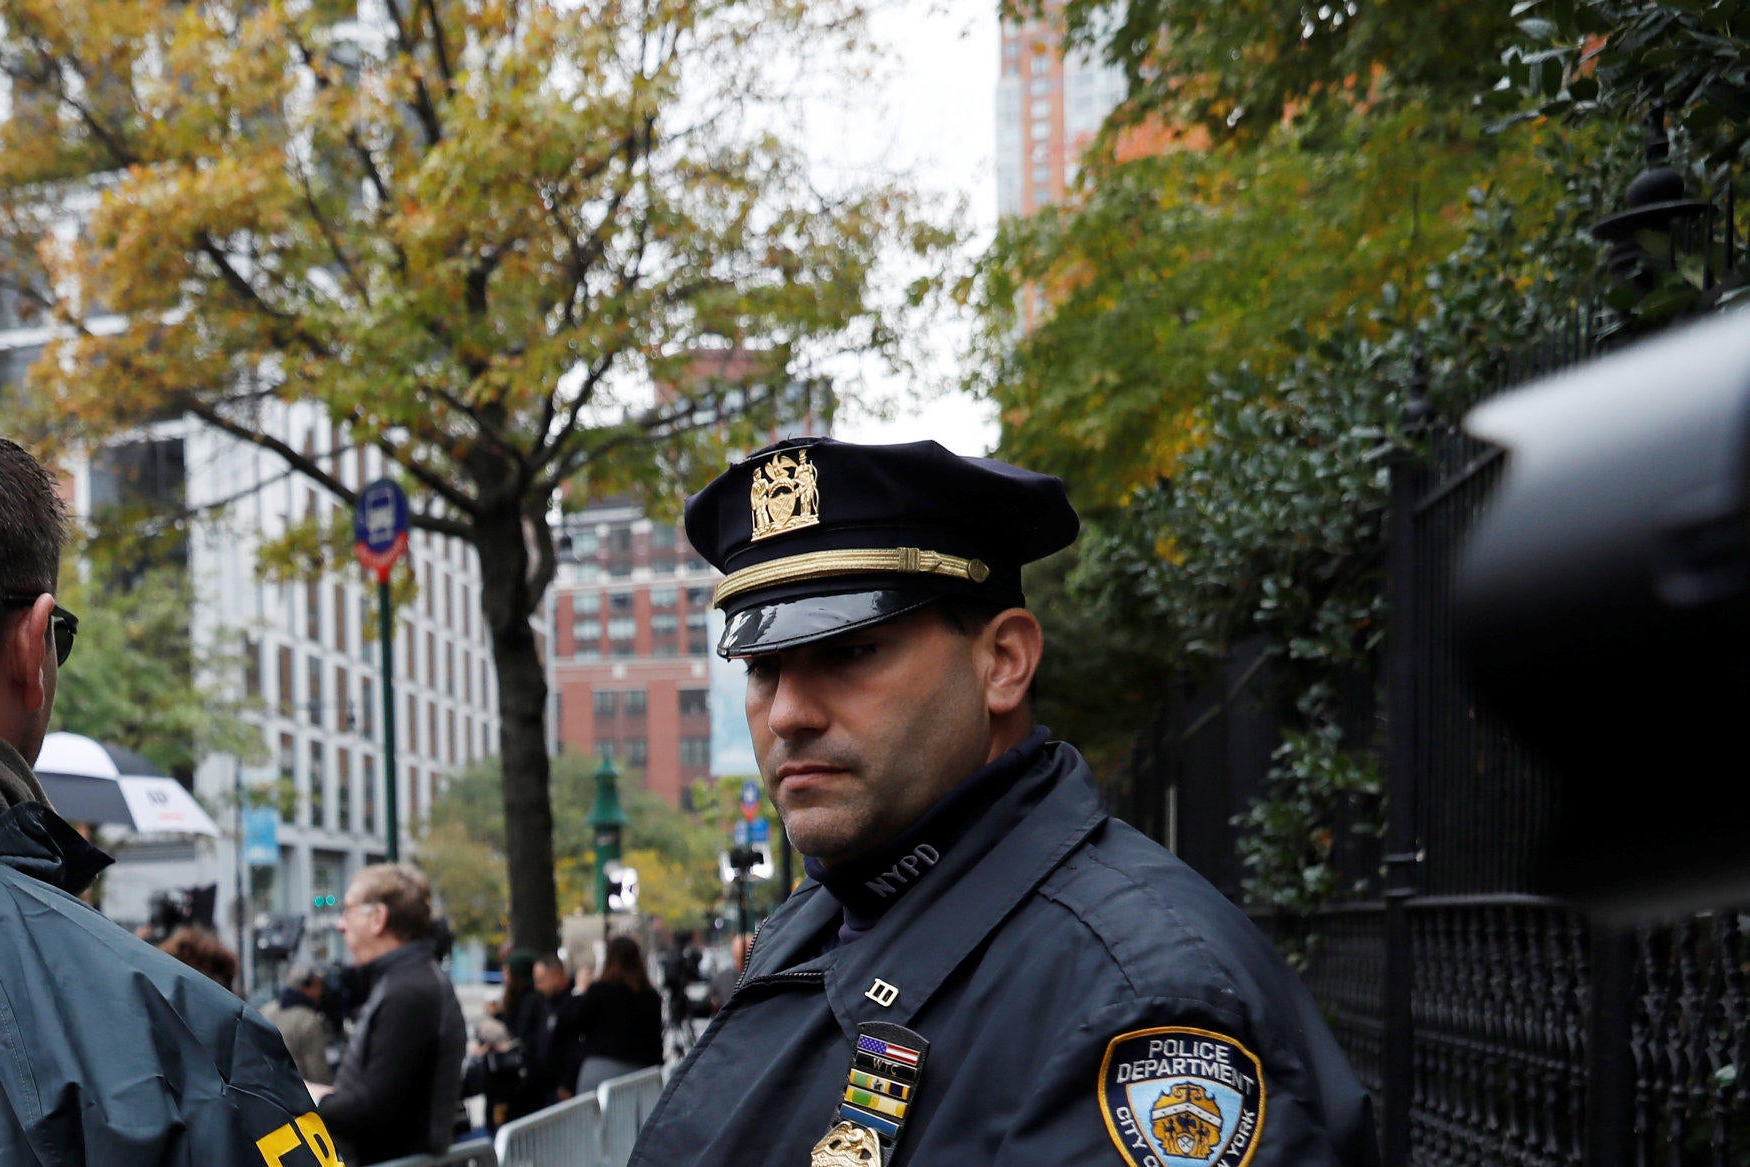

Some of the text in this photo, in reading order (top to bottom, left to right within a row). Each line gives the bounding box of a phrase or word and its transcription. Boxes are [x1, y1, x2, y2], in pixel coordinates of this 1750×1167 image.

[864, 843, 940, 898] NYPD
[872, 1057, 899, 1076] WTC
[1148, 1038, 1230, 1064] POLICE
[1116, 1057, 1255, 1096] DEPARTMENT
[1116, 1106, 1148, 1150] CITY
[1226, 1108, 1256, 1158] YORK
